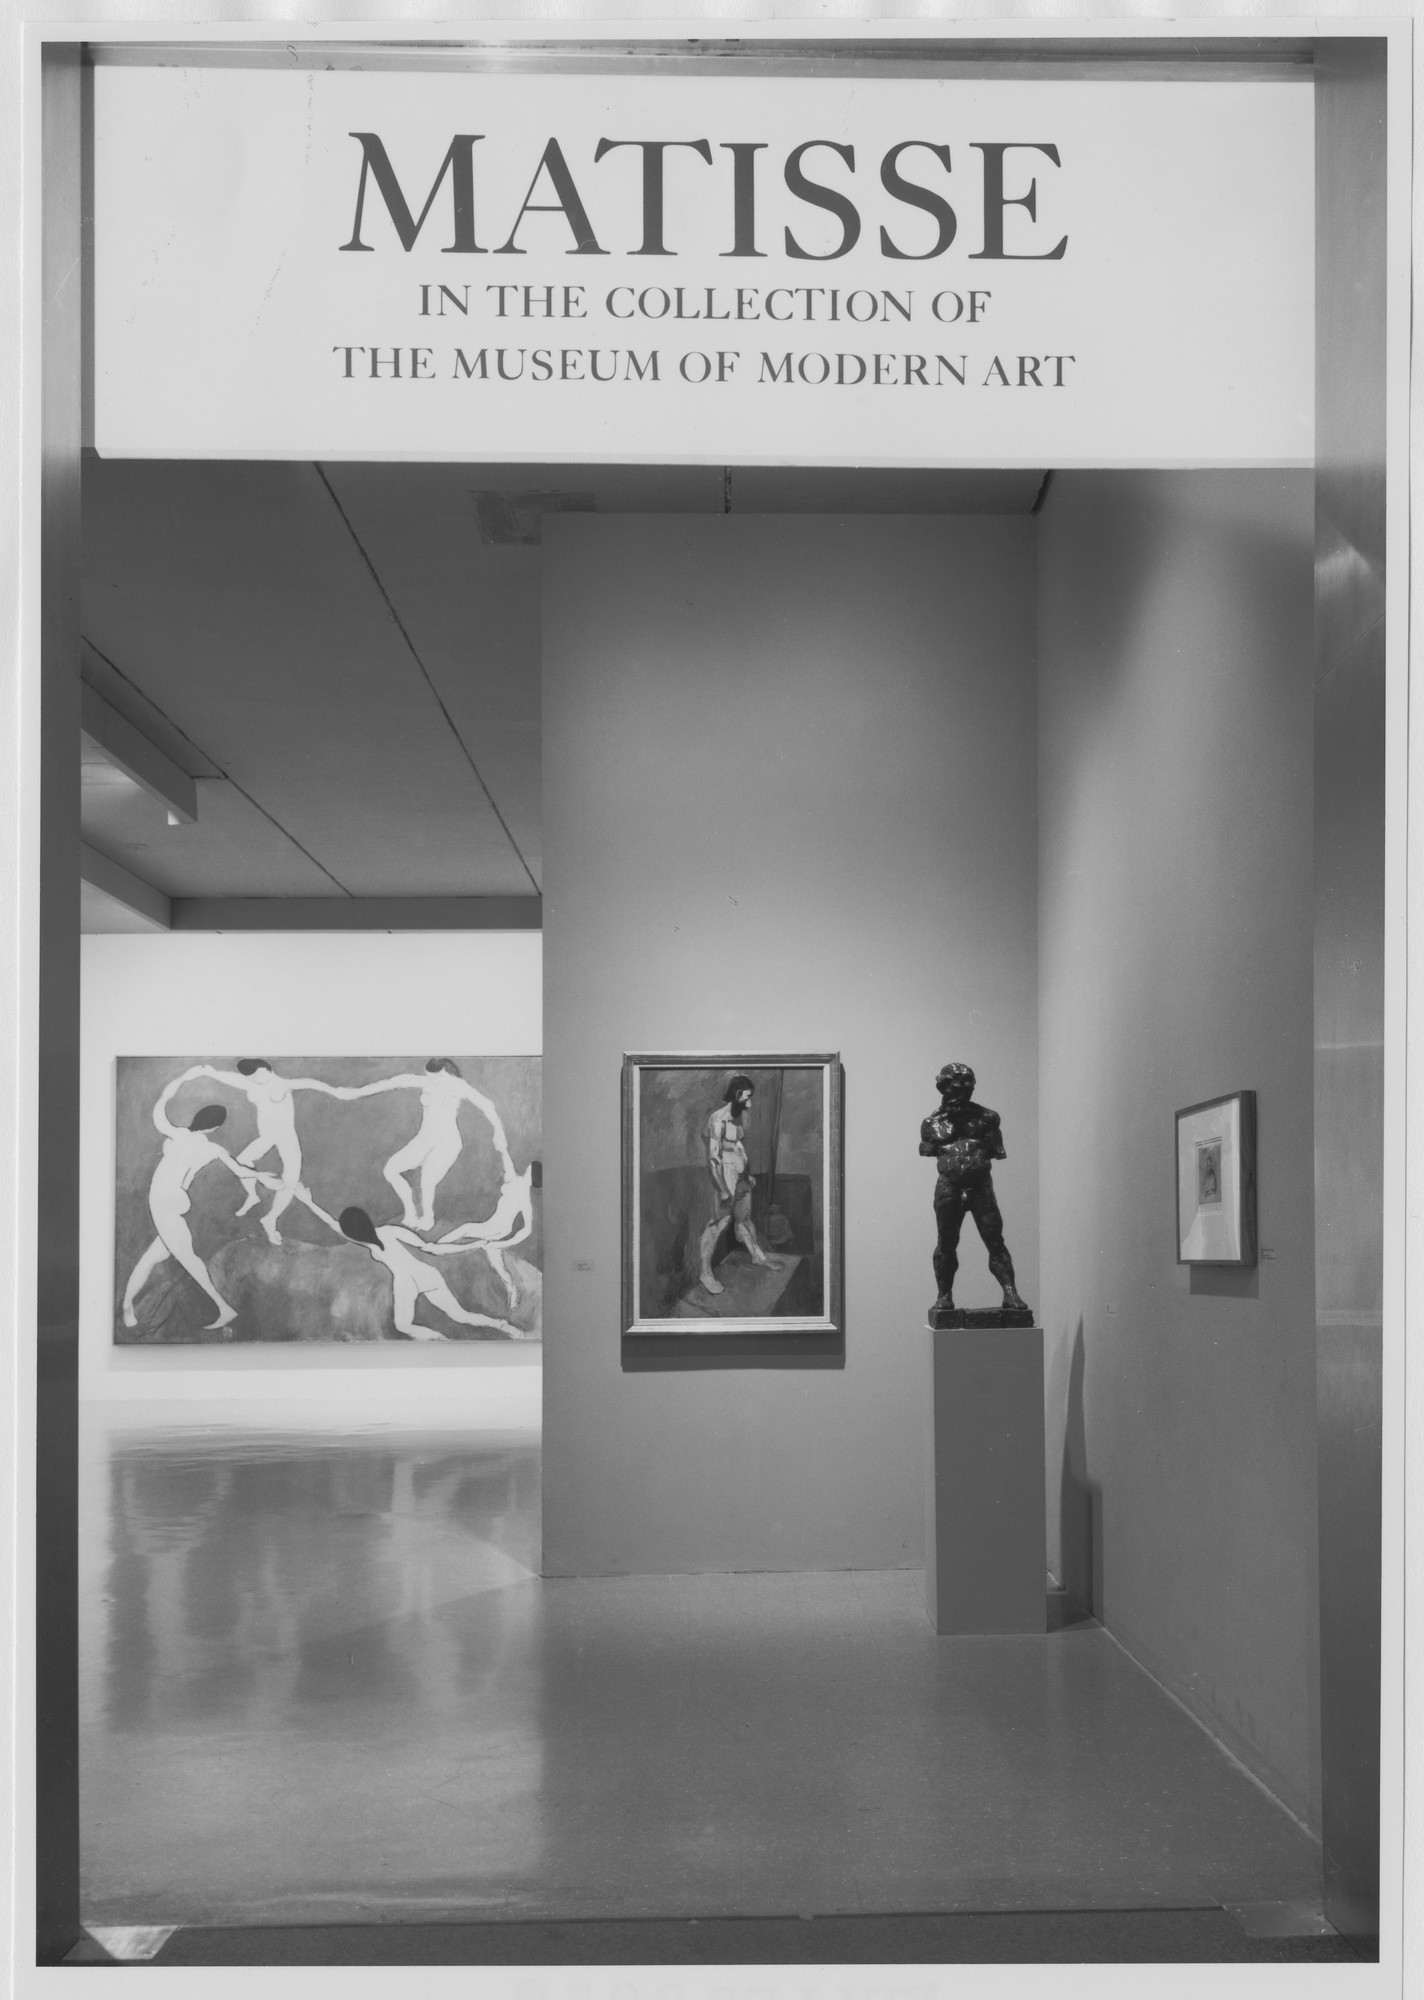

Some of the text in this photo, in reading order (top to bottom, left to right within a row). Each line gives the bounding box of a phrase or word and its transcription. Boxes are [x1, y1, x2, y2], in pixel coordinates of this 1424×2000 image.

[338, 132, 1069, 261] MATISSE
[418, 284, 992, 323] IN THE COLLECTION OF
[333, 346, 1077, 387] THE MUSEUM OF MODERN ART
